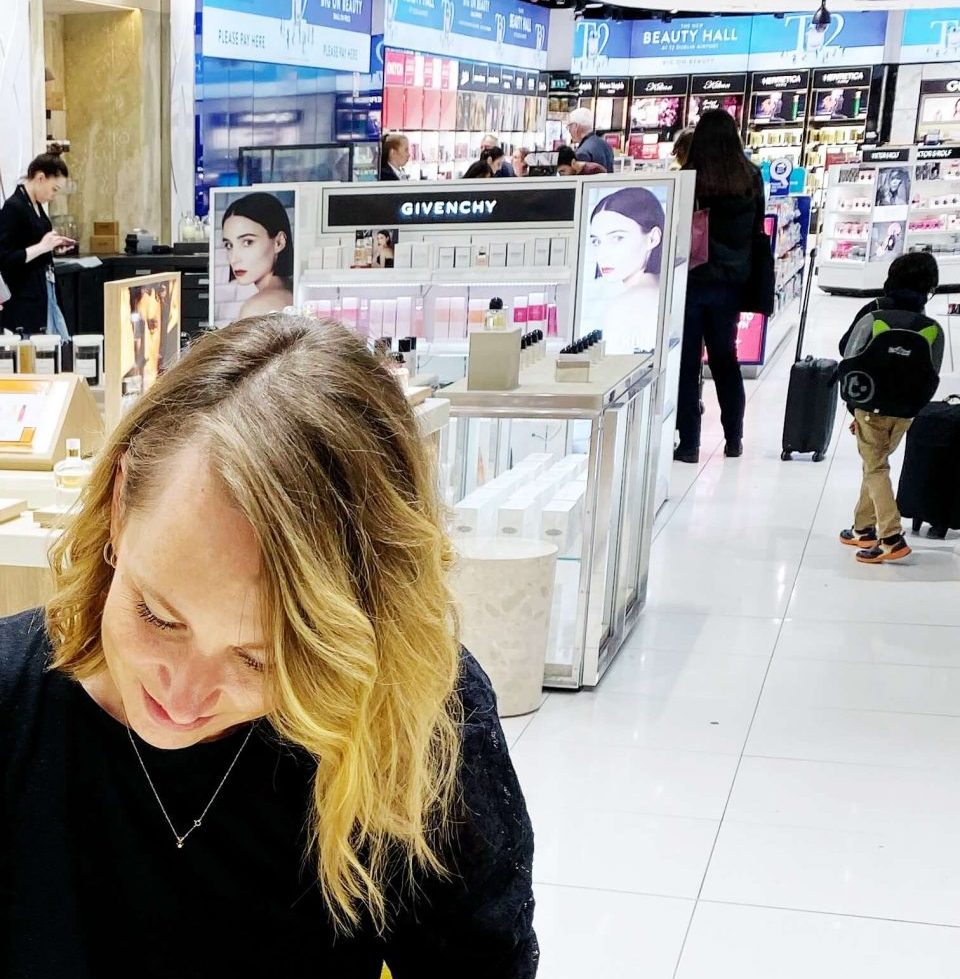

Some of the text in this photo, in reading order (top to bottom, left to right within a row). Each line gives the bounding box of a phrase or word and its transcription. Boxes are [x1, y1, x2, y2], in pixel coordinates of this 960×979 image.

[218, 29, 265, 48] PLEASE PAY HERE
[643, 27, 738, 44] BEAUTY HALL
[401, 200, 497, 216] GIVENCHY
